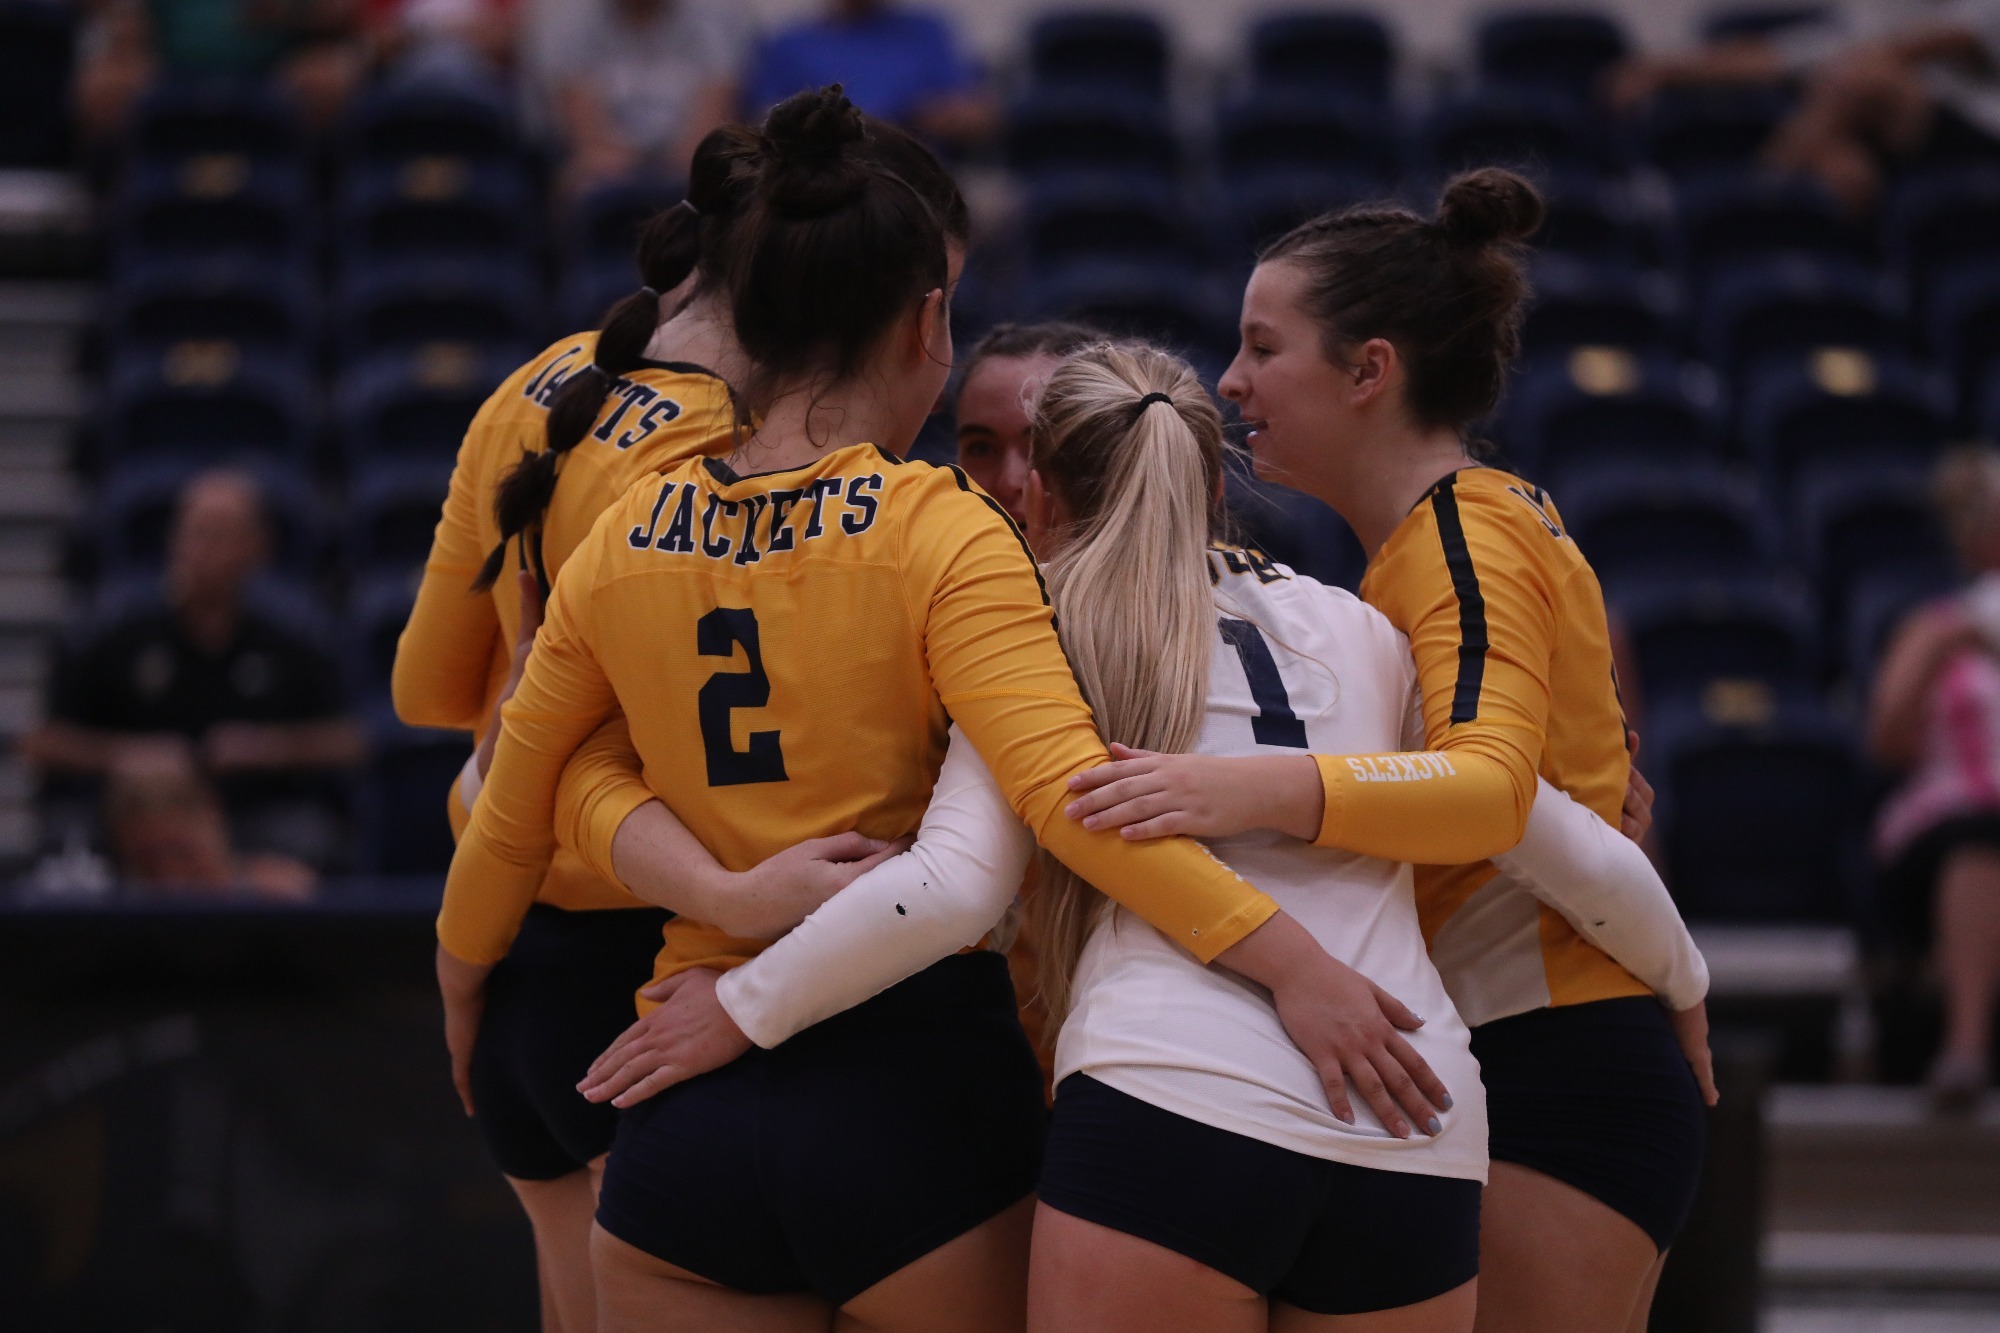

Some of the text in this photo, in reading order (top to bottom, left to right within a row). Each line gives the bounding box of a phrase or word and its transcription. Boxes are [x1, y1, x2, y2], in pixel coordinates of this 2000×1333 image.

[697, 607, 790, 786] 2
[1217, 616, 1308, 749] 1
[1346, 752, 1457, 782] JACKETS
